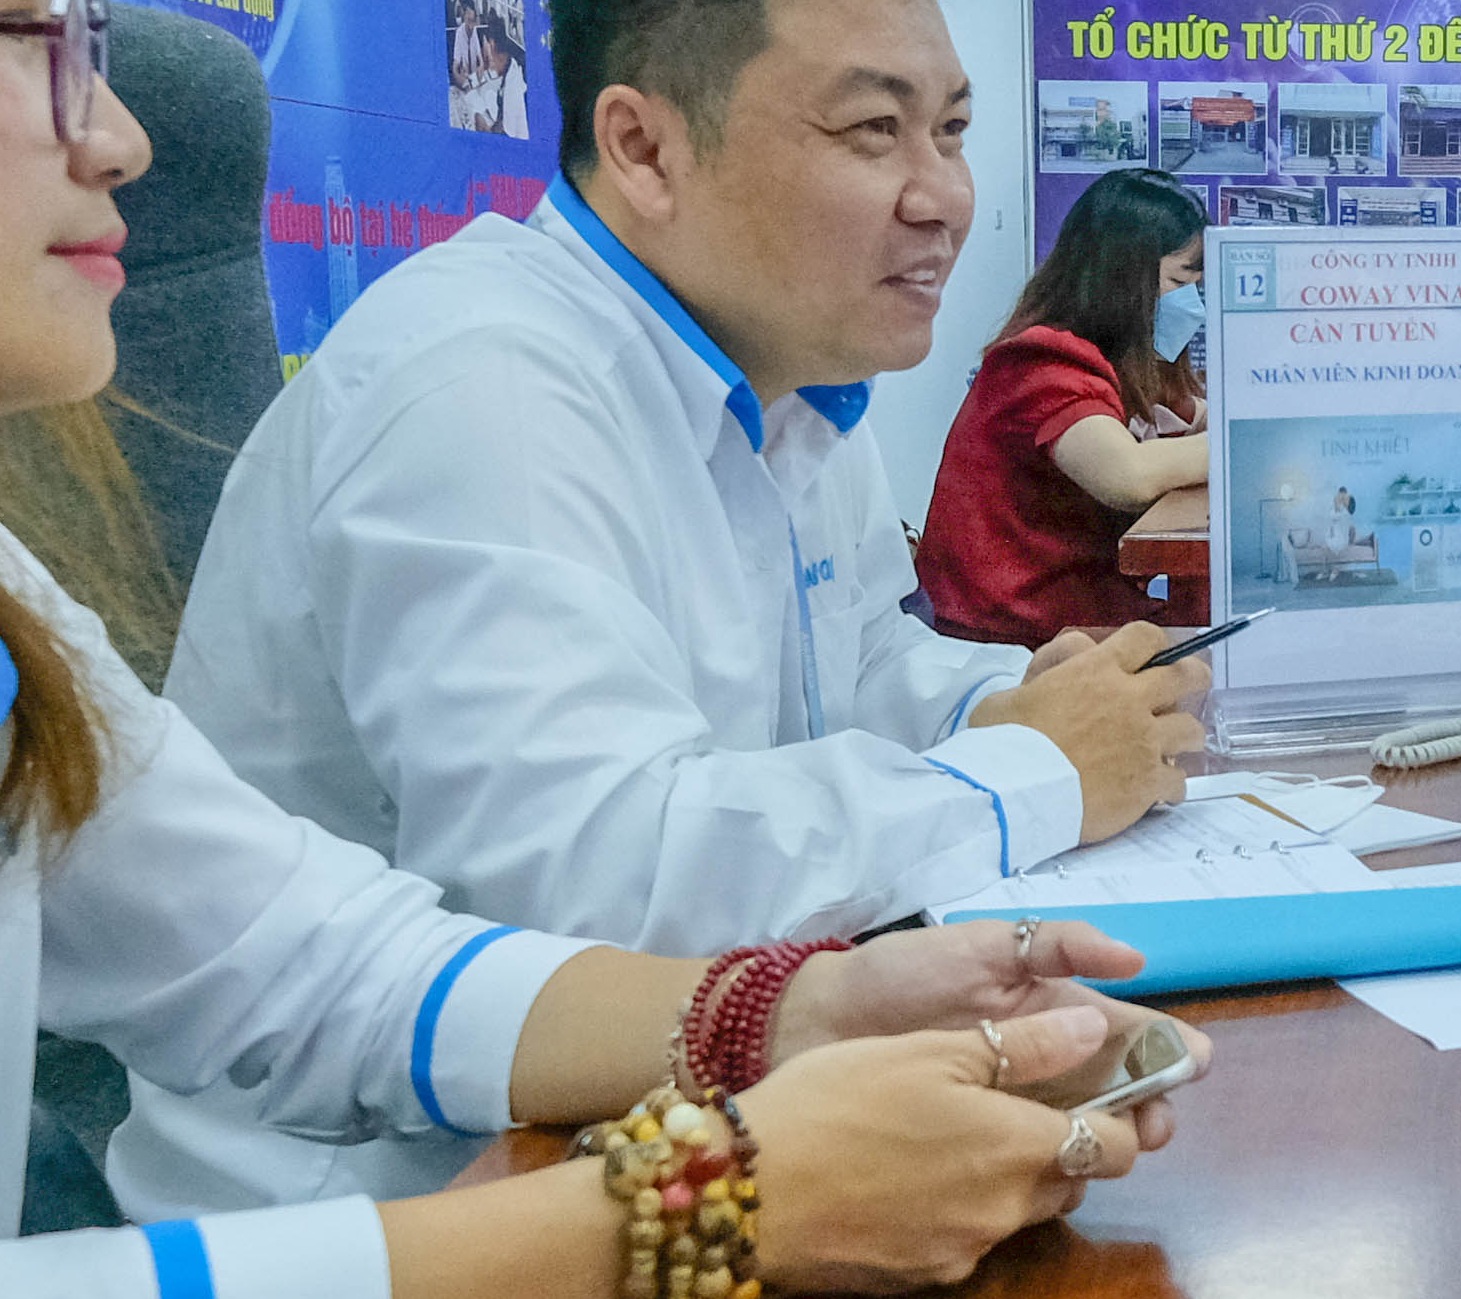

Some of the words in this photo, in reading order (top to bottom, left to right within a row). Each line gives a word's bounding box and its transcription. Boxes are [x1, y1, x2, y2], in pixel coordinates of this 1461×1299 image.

[1067, 6, 1117, 60] TỔ
[1126, 14, 1230, 60] CHỨC
[1240, 14, 1295, 61] TỪ
[1299, 15, 1378, 63] THỨ
[1383, 23, 1410, 63] 2
[1311, 249, 1367, 270] CÔNG
[1375, 253, 1396, 269] TY
[1405, 252, 1457, 269] TNHH
[1238, 274, 1264, 297] 12
[1301, 284, 1399, 306] COWAY
[1251, 364, 1307, 384] NHÂN
[1312, 362, 1358, 383] VIÊN
[1363, 364, 1412, 382] KINH
